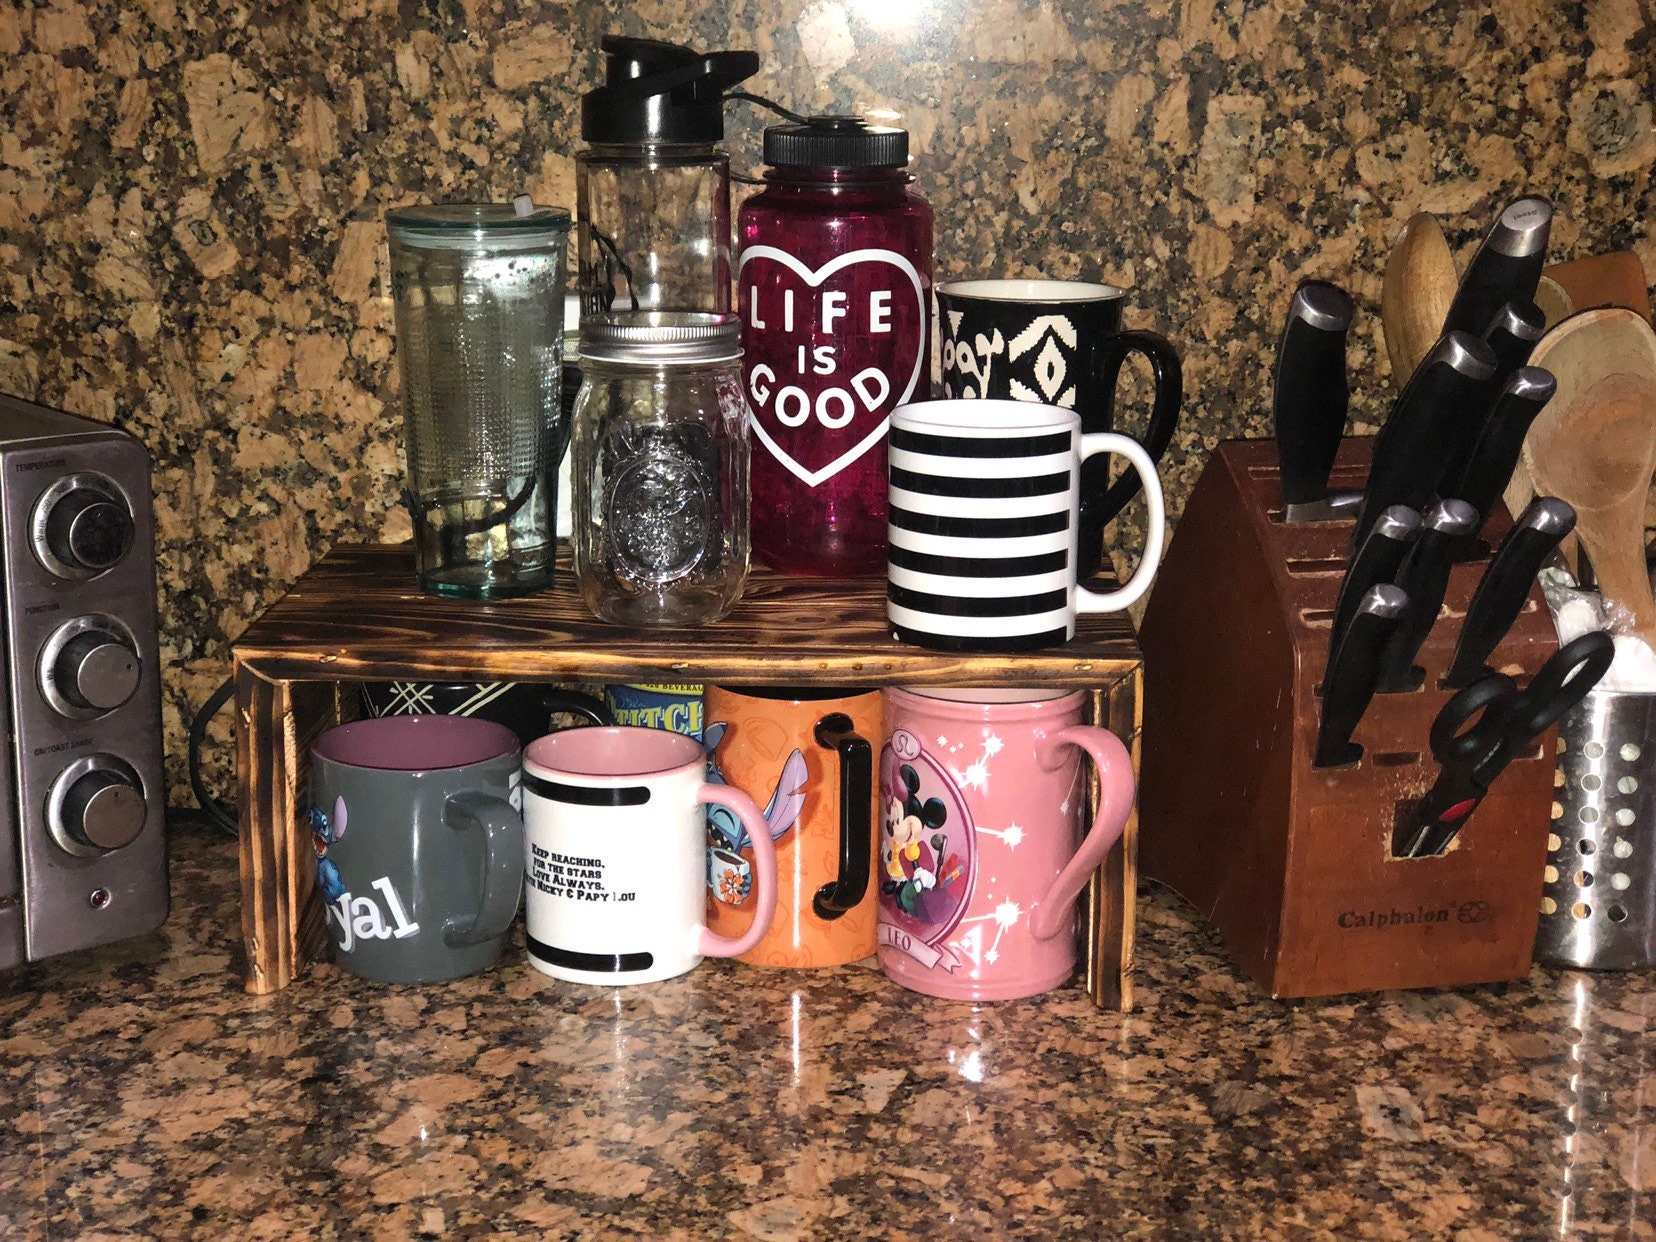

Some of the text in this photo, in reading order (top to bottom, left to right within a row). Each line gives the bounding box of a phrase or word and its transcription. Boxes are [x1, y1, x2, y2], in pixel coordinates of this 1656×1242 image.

[751, 285, 892, 334] LIFE
[797, 345, 837, 375] IS
[750, 363, 890, 429] GOOD
[325, 876, 420, 953] yal
[1337, 906, 1450, 929] Calphalon
[888, 927, 911, 951] LEO
